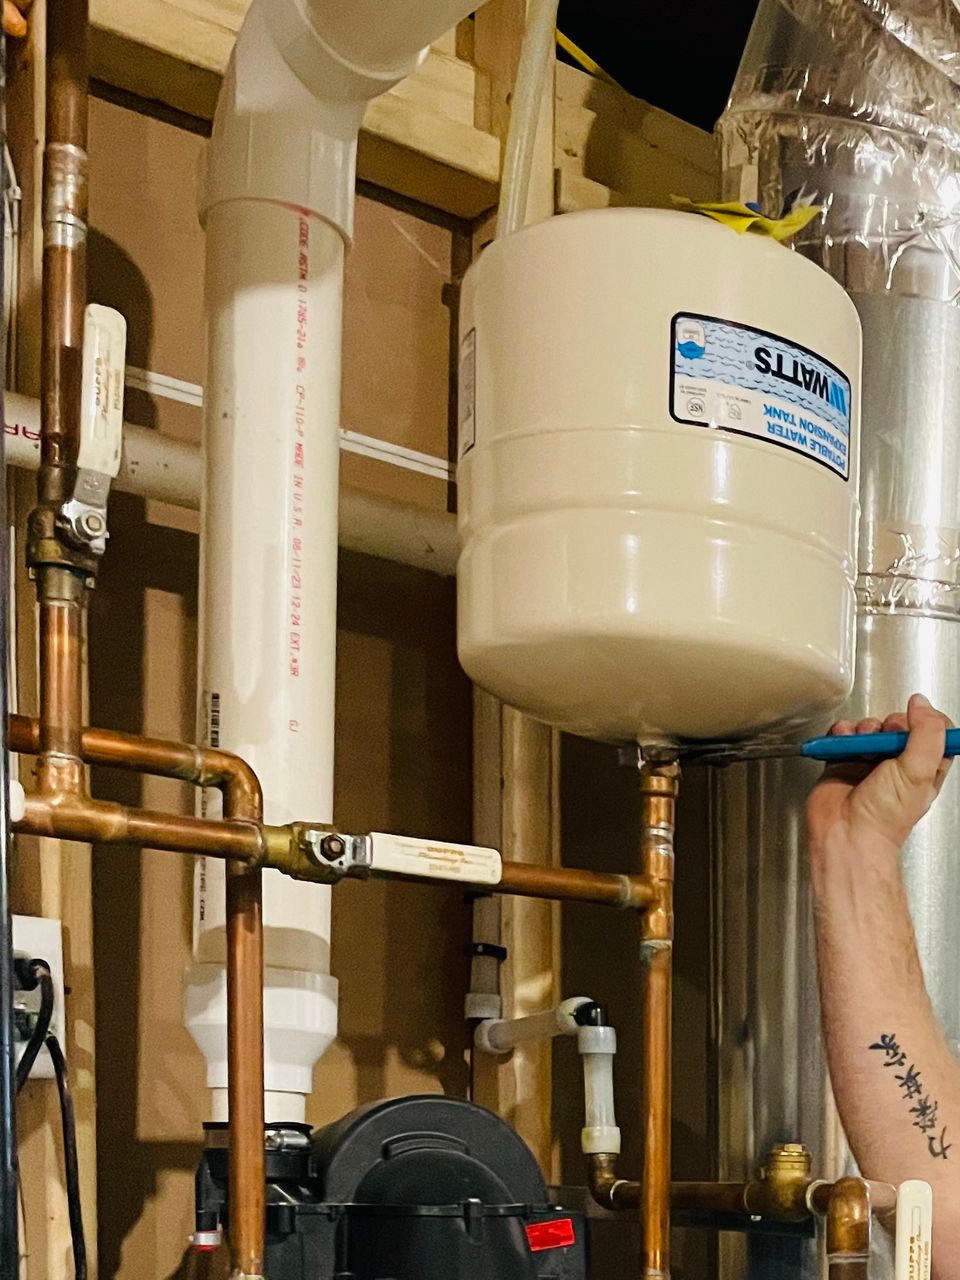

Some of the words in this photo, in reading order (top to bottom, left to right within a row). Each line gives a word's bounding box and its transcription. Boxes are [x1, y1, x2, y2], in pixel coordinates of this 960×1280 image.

[299, 252, 309, 280] ASTM
[754, 347, 830, 401] WATTS
[763, 403, 797, 427] TANK
[767, 421, 807, 447] WATER
[800, 421, 847, 456] EXPANSION
[294, 442, 304, 469] MADE
[810, 441, 846, 471] POTABLE
[294, 474, 303, 488] IN
